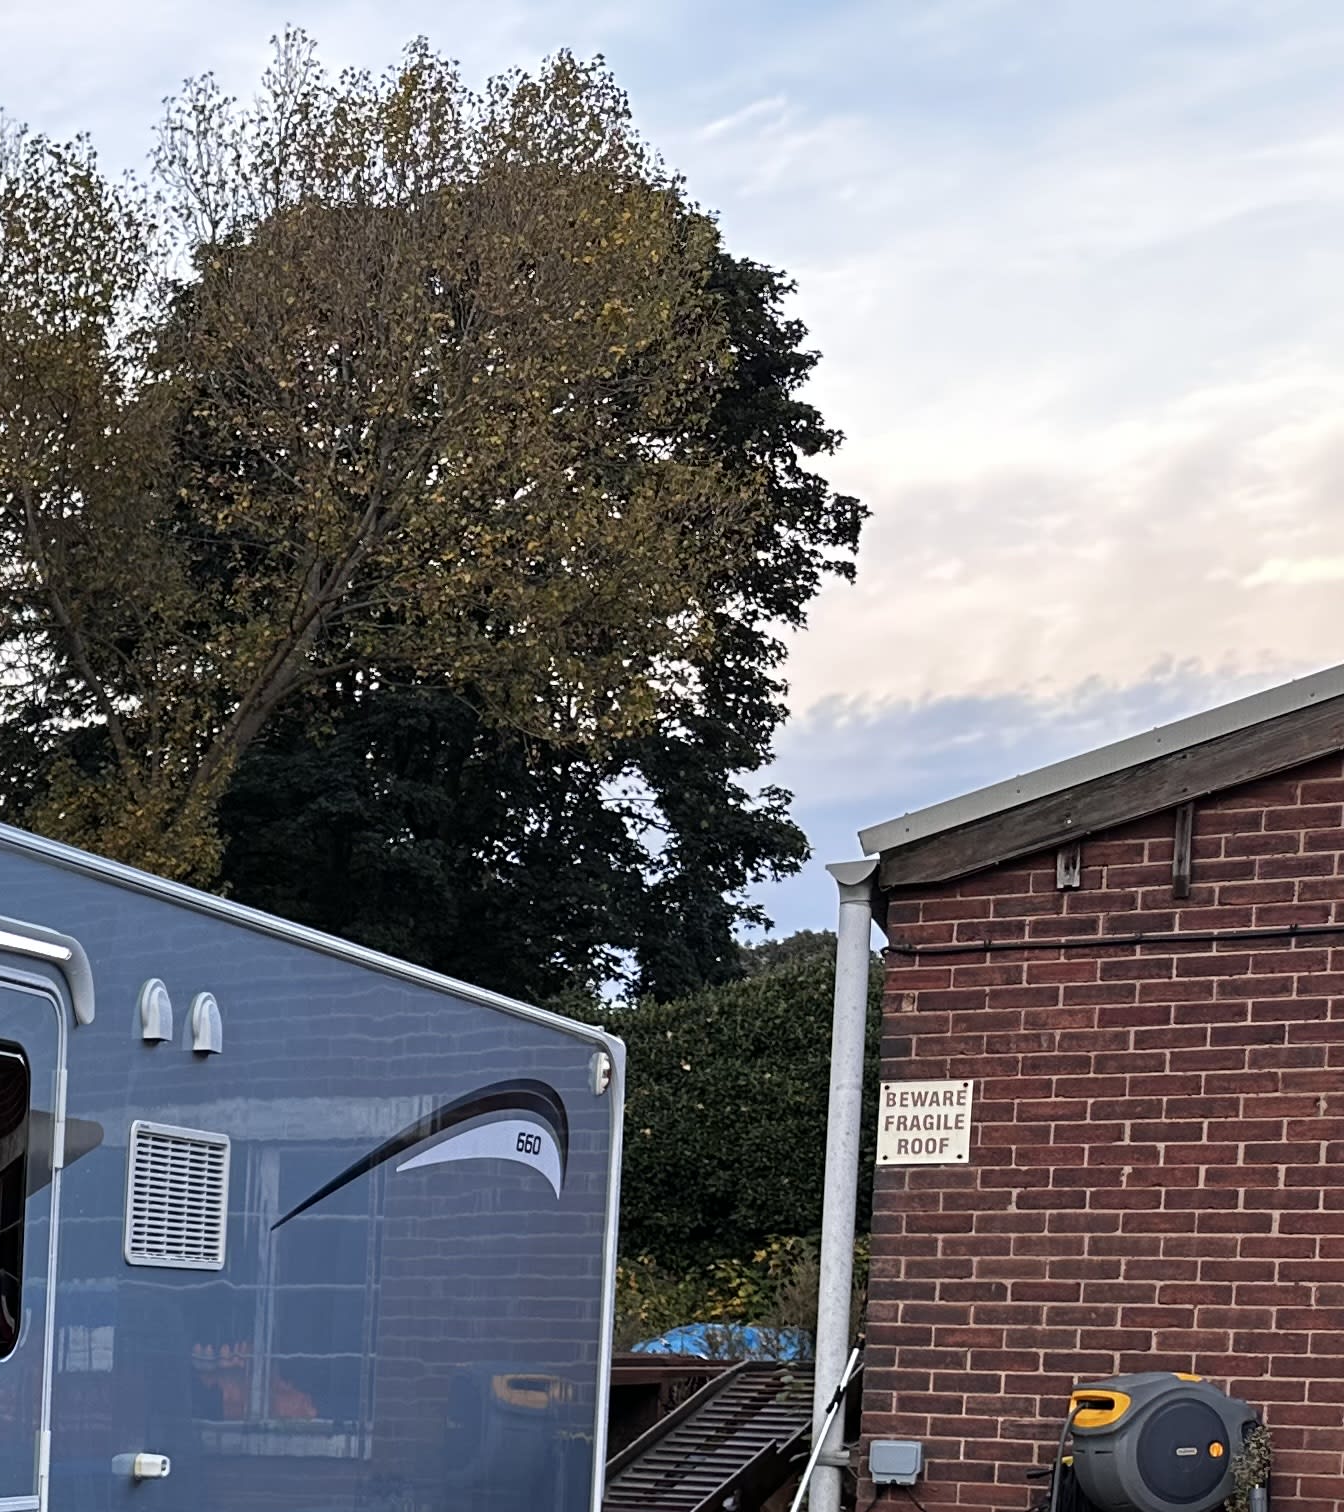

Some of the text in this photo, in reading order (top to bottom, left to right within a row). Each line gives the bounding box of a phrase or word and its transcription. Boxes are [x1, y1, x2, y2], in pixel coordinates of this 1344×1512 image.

[886, 1090, 967, 1108] BEWARE
[884, 1114, 965, 1132] FRAGILE
[516, 1132, 542, 1156] 660
[897, 1137, 950, 1155] ROOF
